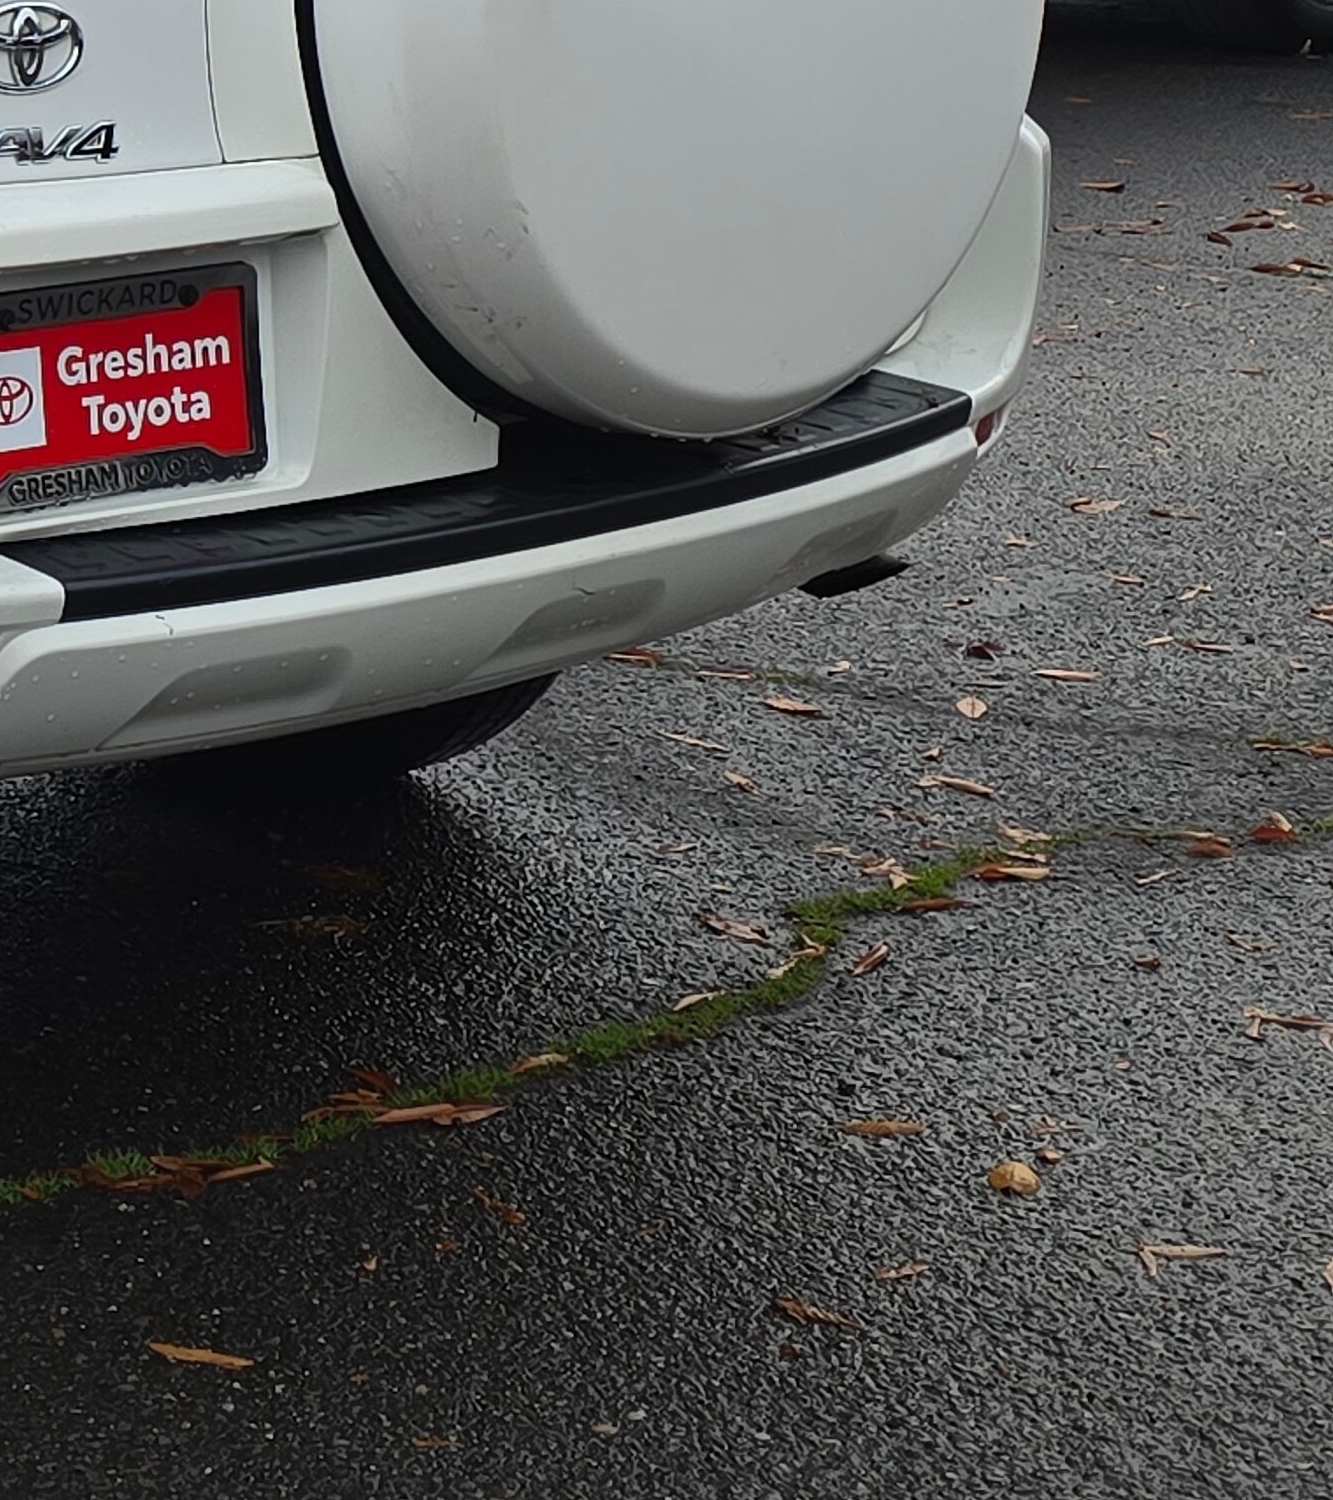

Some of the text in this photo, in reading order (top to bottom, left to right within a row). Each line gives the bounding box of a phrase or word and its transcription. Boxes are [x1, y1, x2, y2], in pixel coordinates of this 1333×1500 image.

[17, 280, 177, 324] SWICKARD
[56, 333, 231, 386] Gresham
[81, 386, 211, 441] Toyota
[8, 462, 121, 506] GRESHAM
